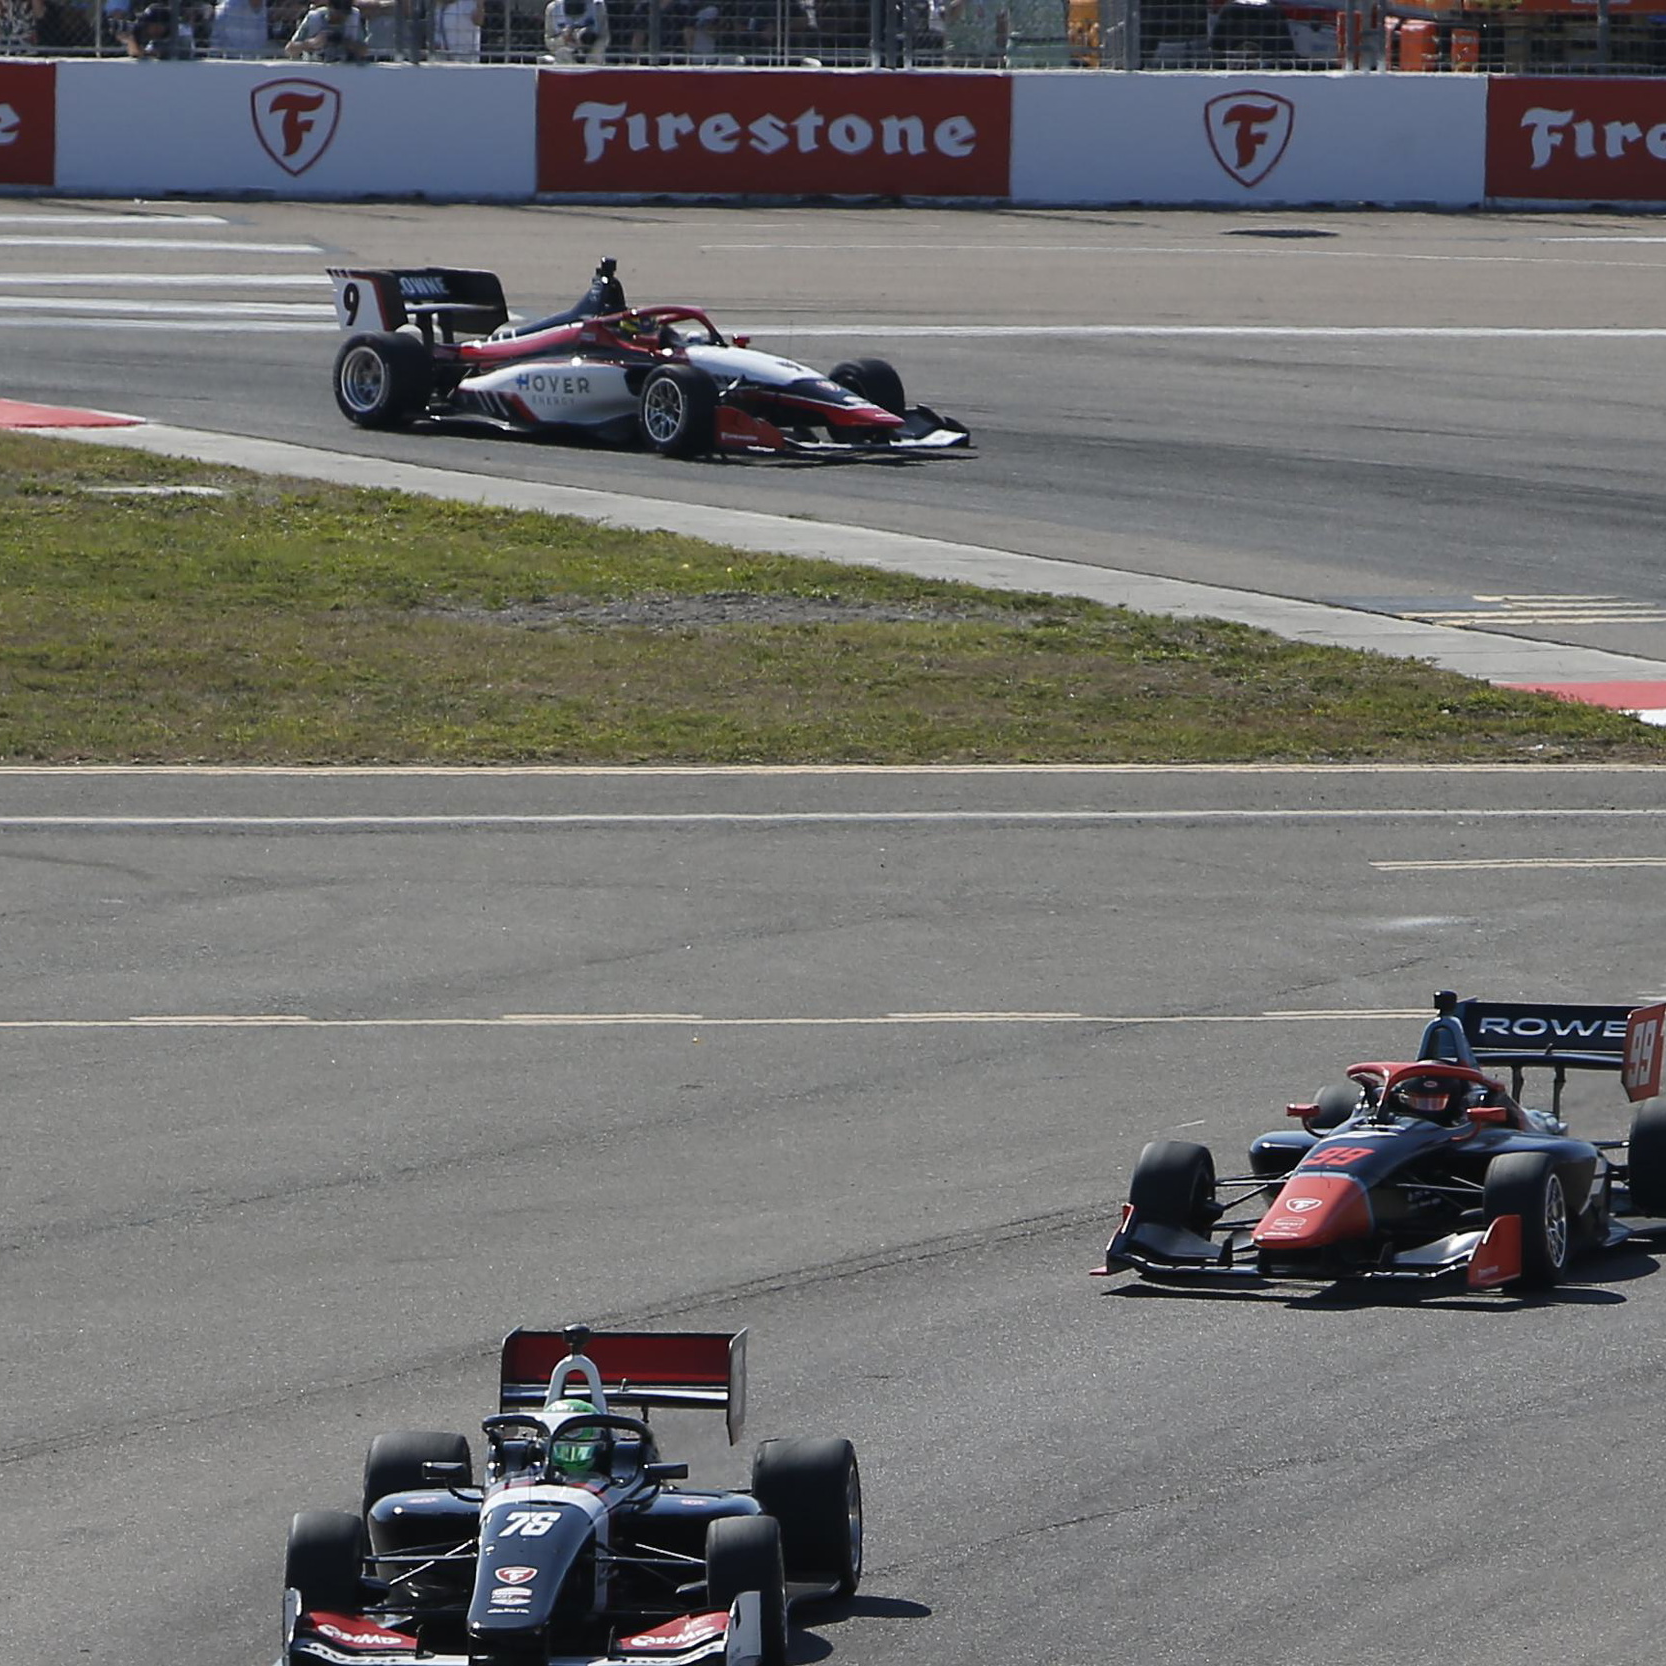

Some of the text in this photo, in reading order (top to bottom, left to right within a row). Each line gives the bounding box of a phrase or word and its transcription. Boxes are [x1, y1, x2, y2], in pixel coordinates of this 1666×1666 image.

[572, 101, 977, 163] Firestone
[343, 282, 360, 327] 9
[516, 373, 591, 394] HOVER
[1479, 1017, 1627, 1038] ROWE
[1628, 1018, 1658, 1089] 99
[1300, 1146, 1376, 1166] 99
[498, 1511, 562, 1537] 76
